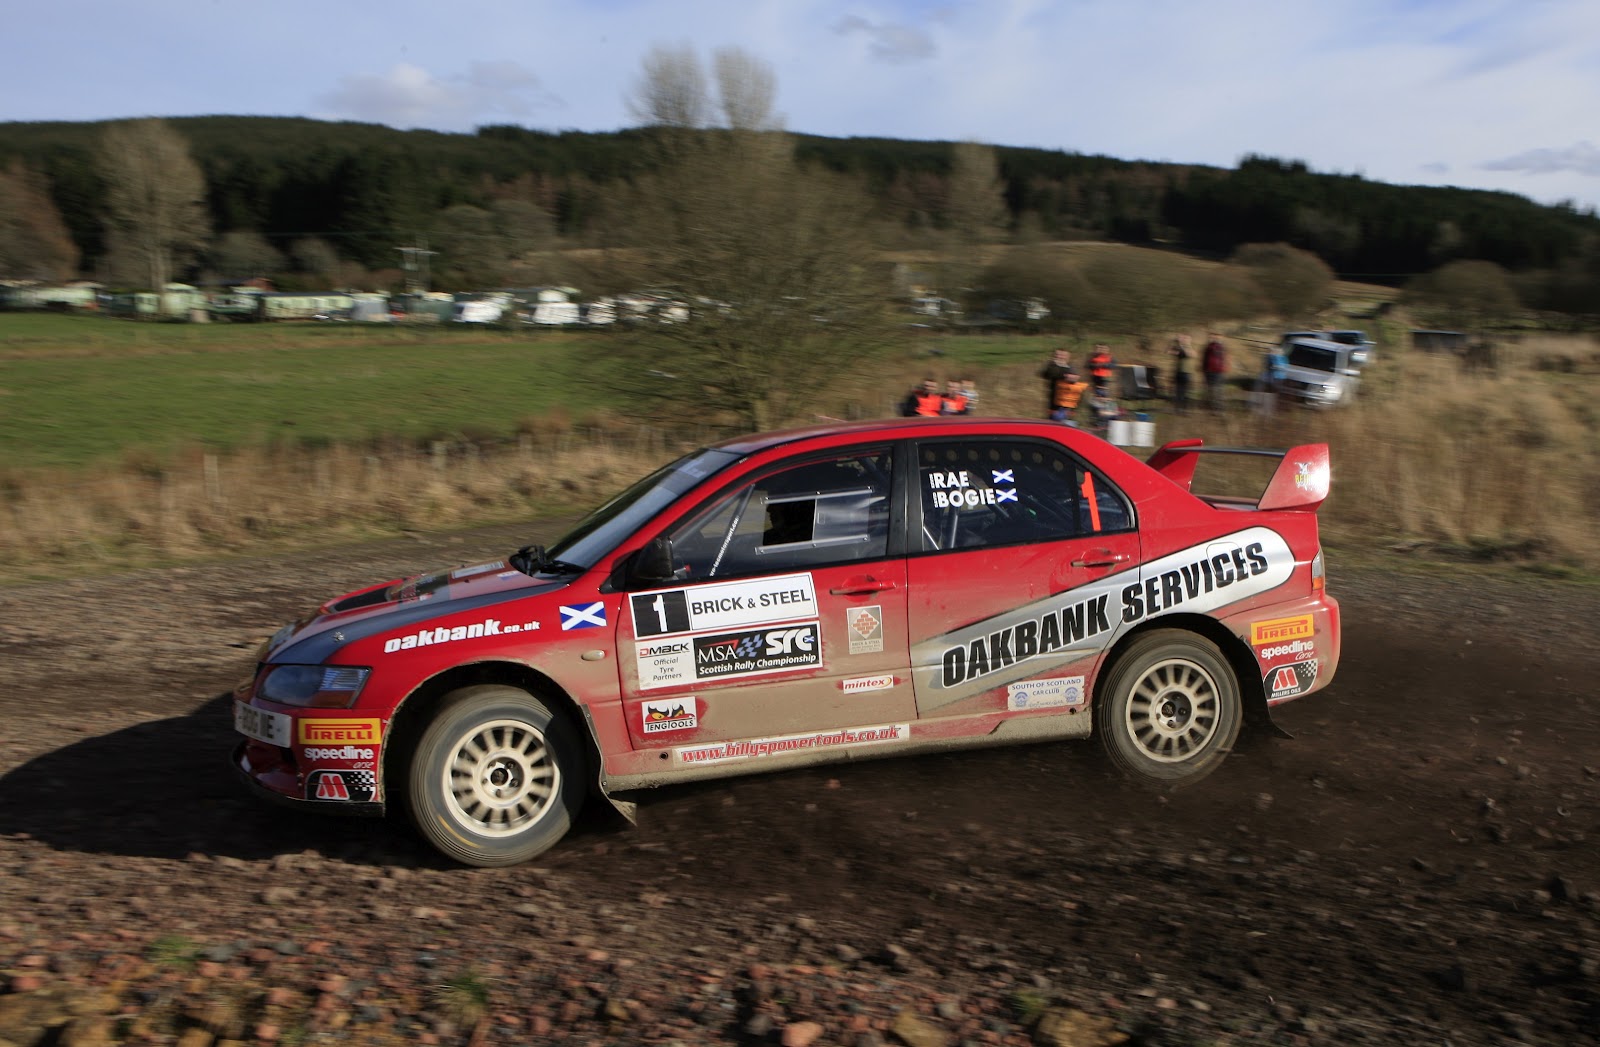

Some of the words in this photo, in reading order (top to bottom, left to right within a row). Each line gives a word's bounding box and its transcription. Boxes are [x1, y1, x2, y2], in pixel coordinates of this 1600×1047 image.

[933, 471, 970, 489] RAE
[937, 488, 996, 508] BOGIE
[1081, 471, 1102, 532] 1
[691, 597, 744, 616] BRICK
[747, 597, 757, 609] &
[759, 589, 811, 607] STEEL
[652, 594, 668, 633] 1
[942, 592, 1112, 689] OAKBANK
[1120, 541, 1269, 624] SERVICES
[384, 618, 541, 654] oakbank.co.uk
[1256, 620, 1308, 641] PIRELLI
[698, 645, 739, 664] MSA
[1261, 640, 1314, 660] speedline
[653, 656, 679, 666] Official
[659, 666, 675, 674] Tyre
[699, 662, 733, 675] Scottish
[734, 660, 755, 671] Rally
[756, 653, 817, 668] Championship
[652, 672, 682, 682] Partners
[844, 679, 885, 690] mintex
[1011, 682, 1035, 690] SOUTH
[1046, 678, 1081, 687] SCOTLAND
[304, 723, 373, 740] PIRELLI
[304, 746, 374, 761] speedline
[681, 725, 900, 763] www.billyspowertools.co.uk
[350, 761, 375, 769] orse
